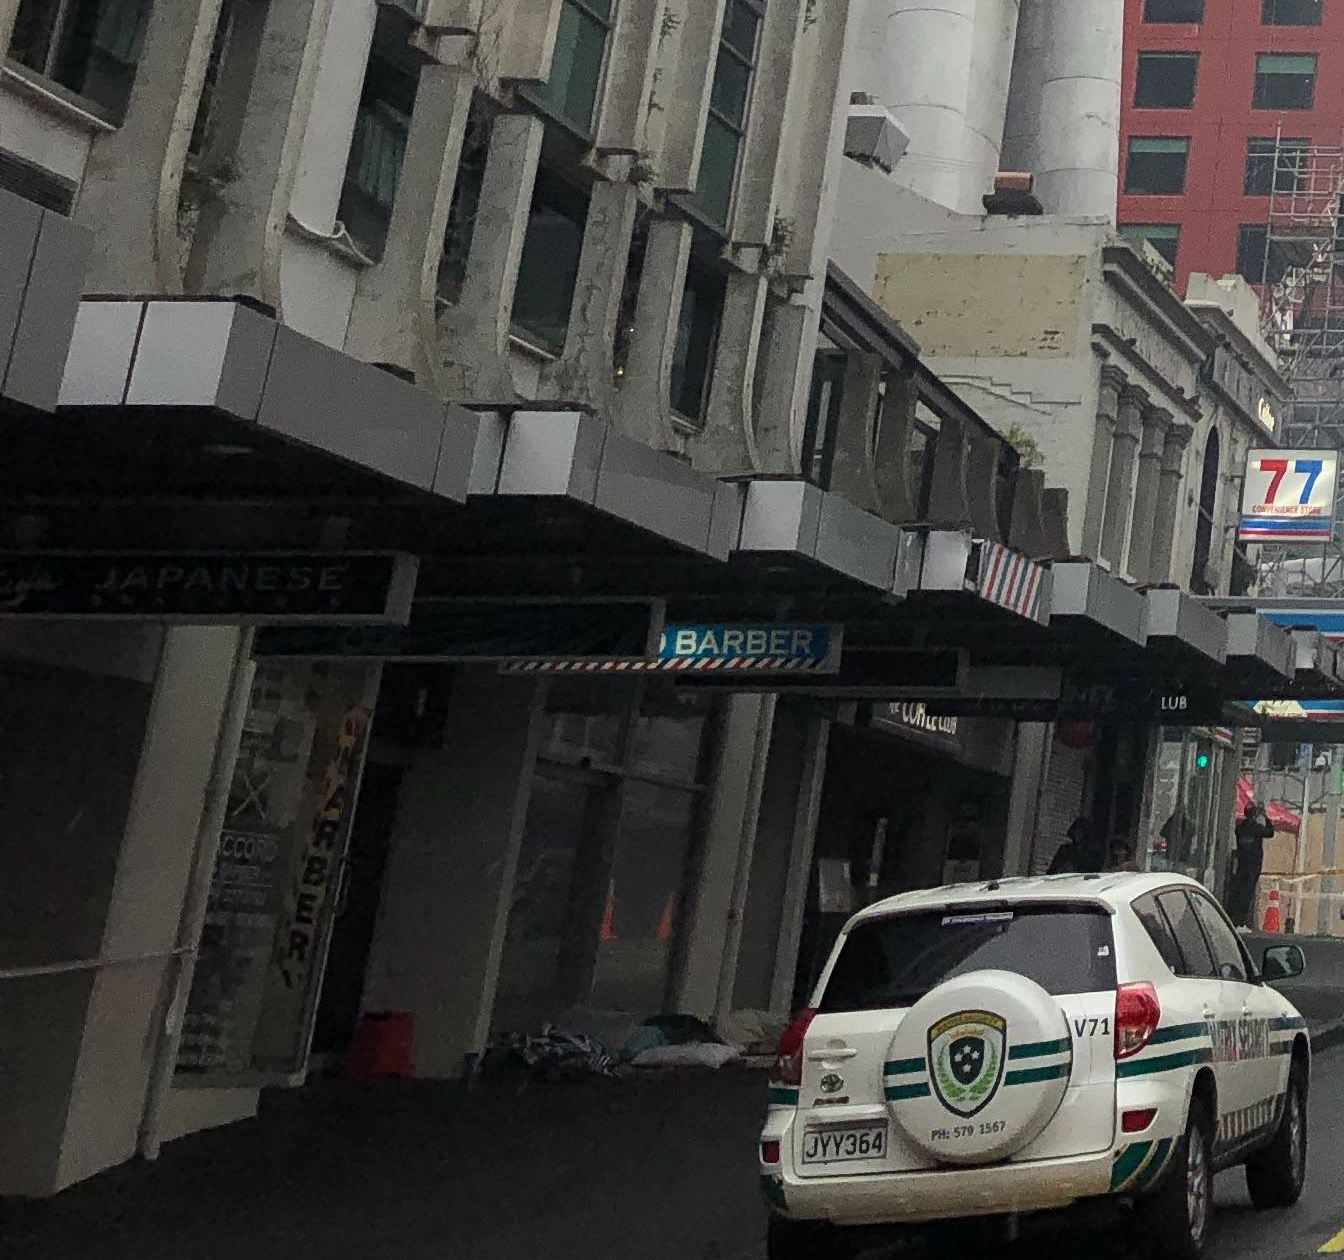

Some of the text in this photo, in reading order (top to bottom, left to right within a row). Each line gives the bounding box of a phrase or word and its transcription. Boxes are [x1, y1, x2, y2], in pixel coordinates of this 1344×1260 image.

[1259, 459, 1323, 505] 77
[95, 563, 348, 591] JAPANESE
[675, 629, 812, 656] BARBER
[1074, 1018, 1110, 1038] V71
[806, 1131, 883, 1158] JYY364
[931, 1121, 1006, 1141] PH: 579 1567
